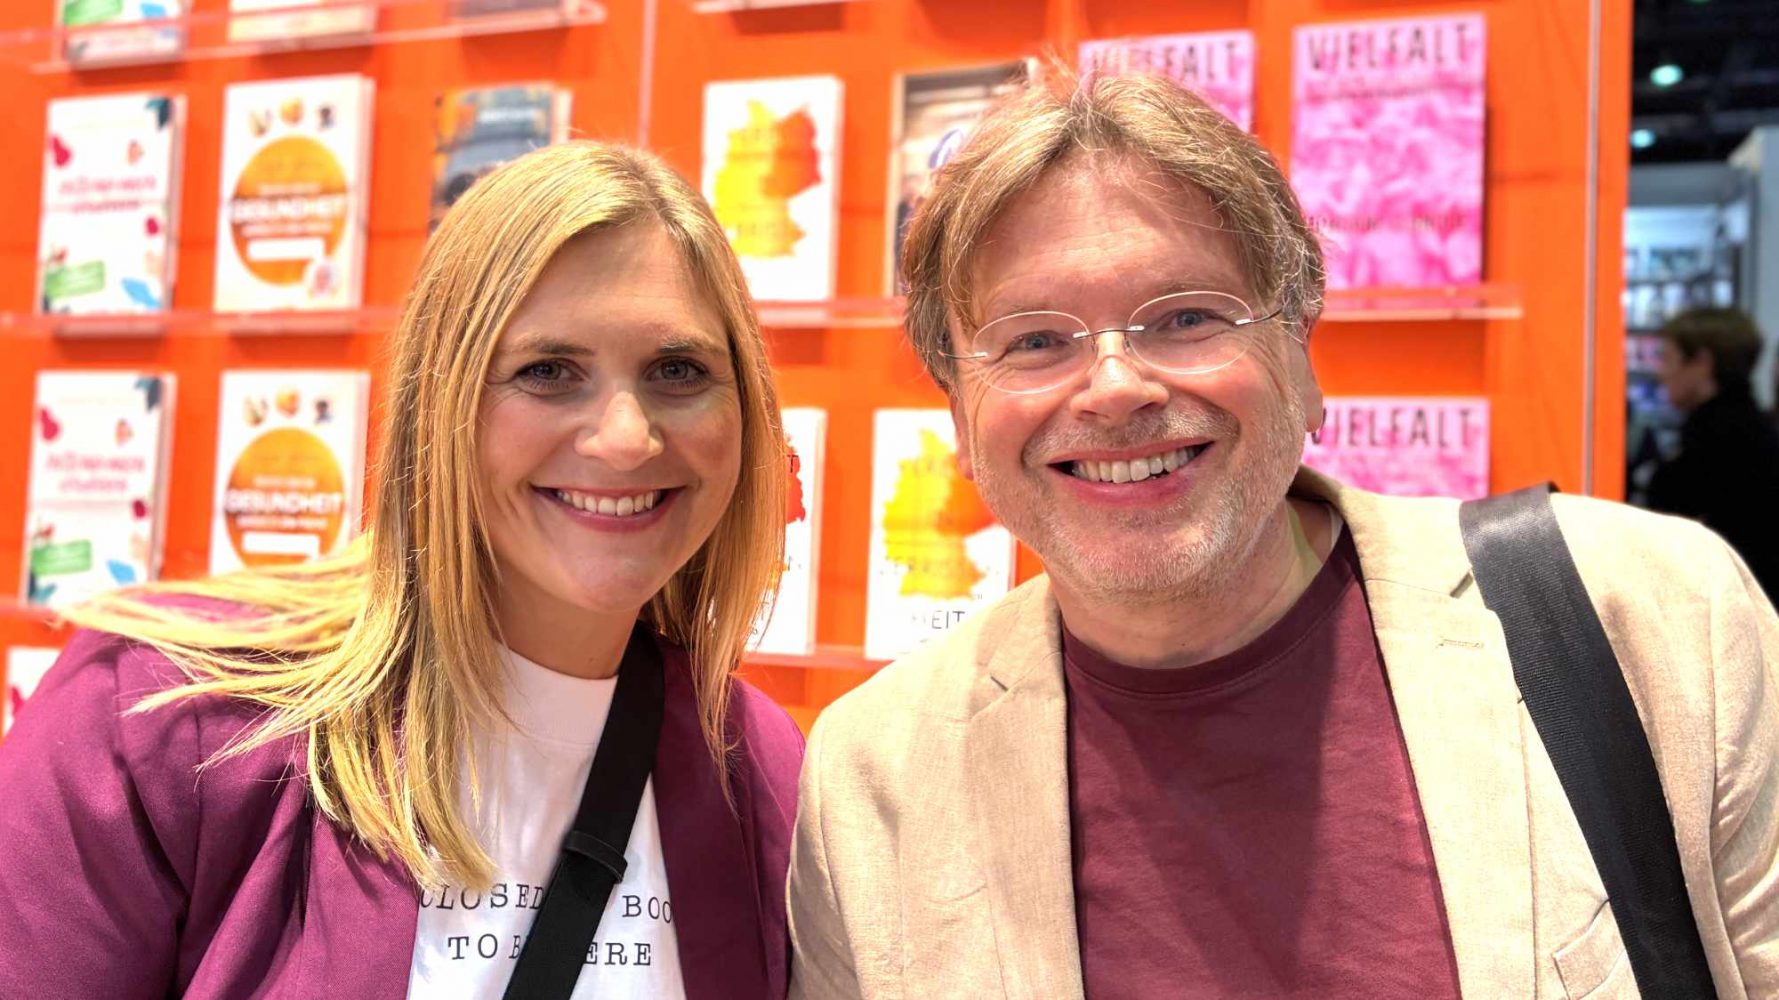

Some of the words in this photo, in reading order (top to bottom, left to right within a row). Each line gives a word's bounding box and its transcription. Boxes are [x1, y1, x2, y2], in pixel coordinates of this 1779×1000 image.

[1308, 22, 1468, 70] VIELFALT
[226, 489, 343, 514] GESUNDHEIT
[447, 933, 498, 960] TO
